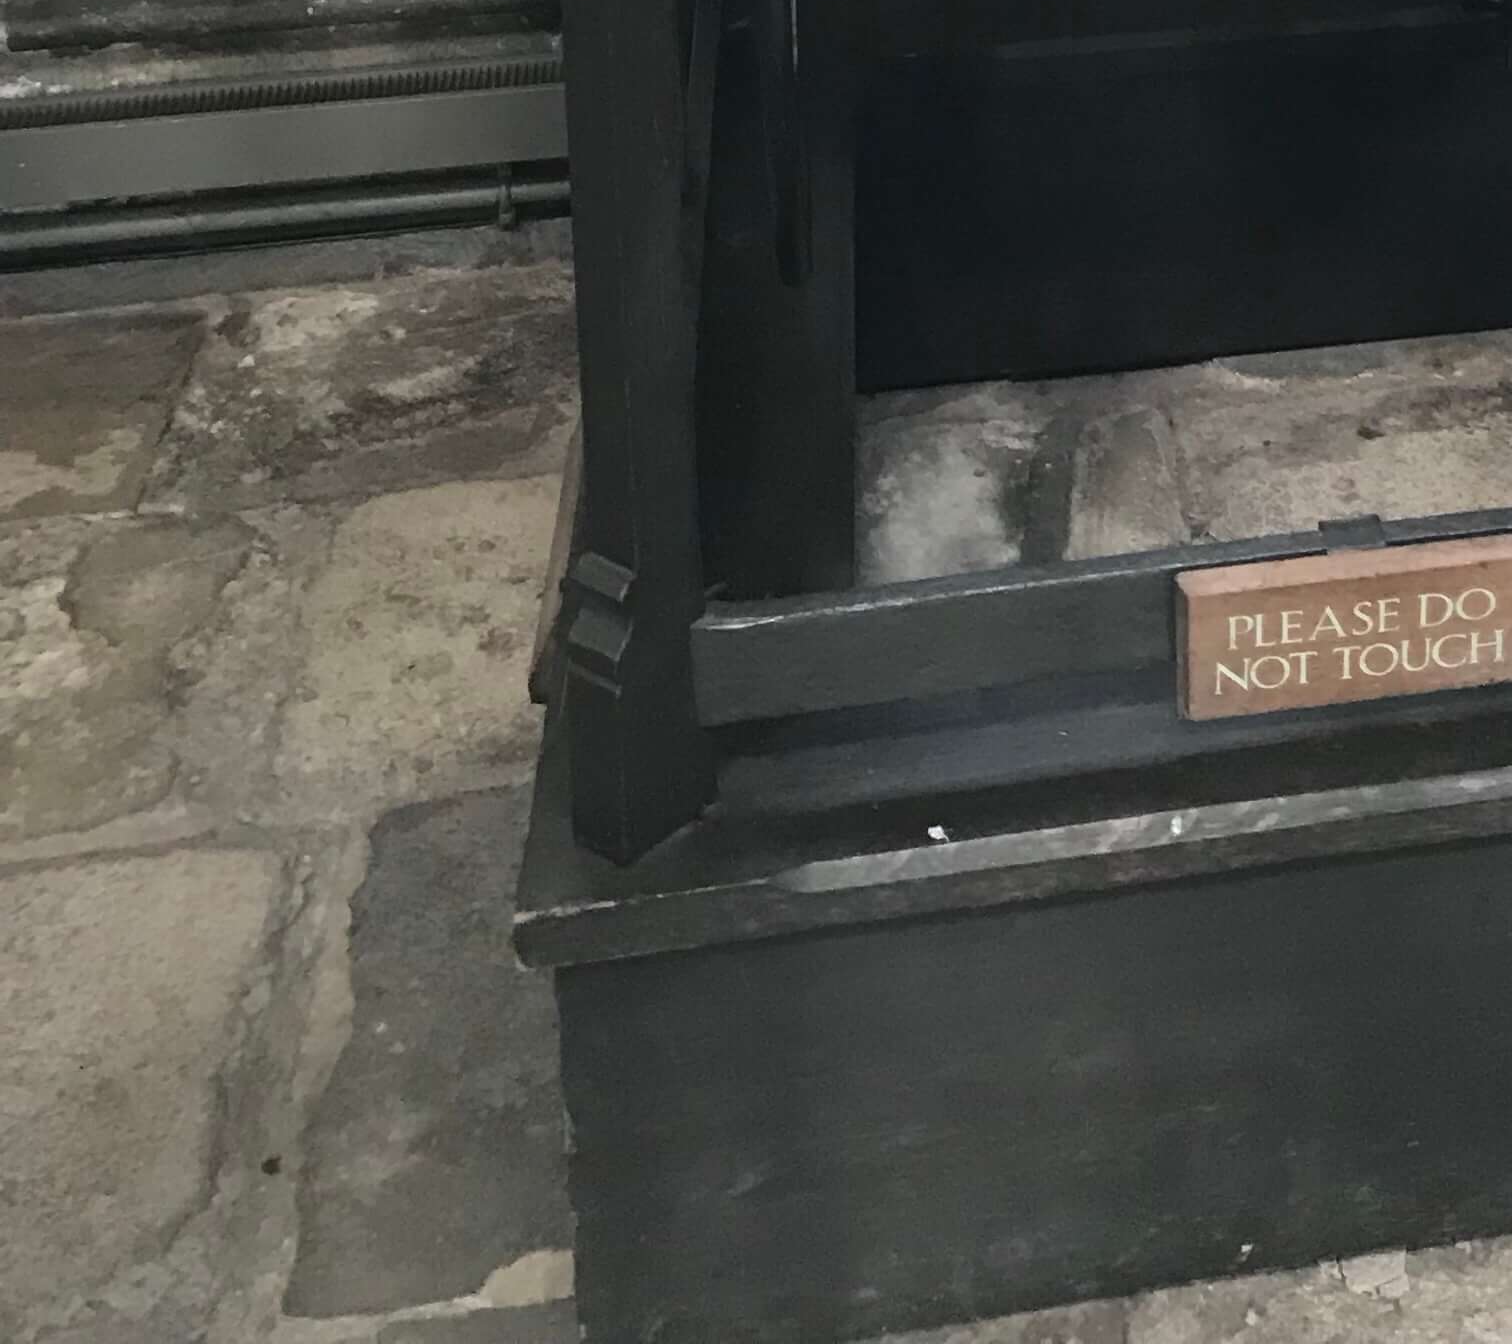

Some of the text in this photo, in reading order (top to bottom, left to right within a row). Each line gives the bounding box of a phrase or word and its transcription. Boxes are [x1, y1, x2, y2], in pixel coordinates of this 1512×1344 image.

[1228, 587, 1497, 650] PLEASE DO
[1214, 628, 1505, 696] NOT TOUCH
